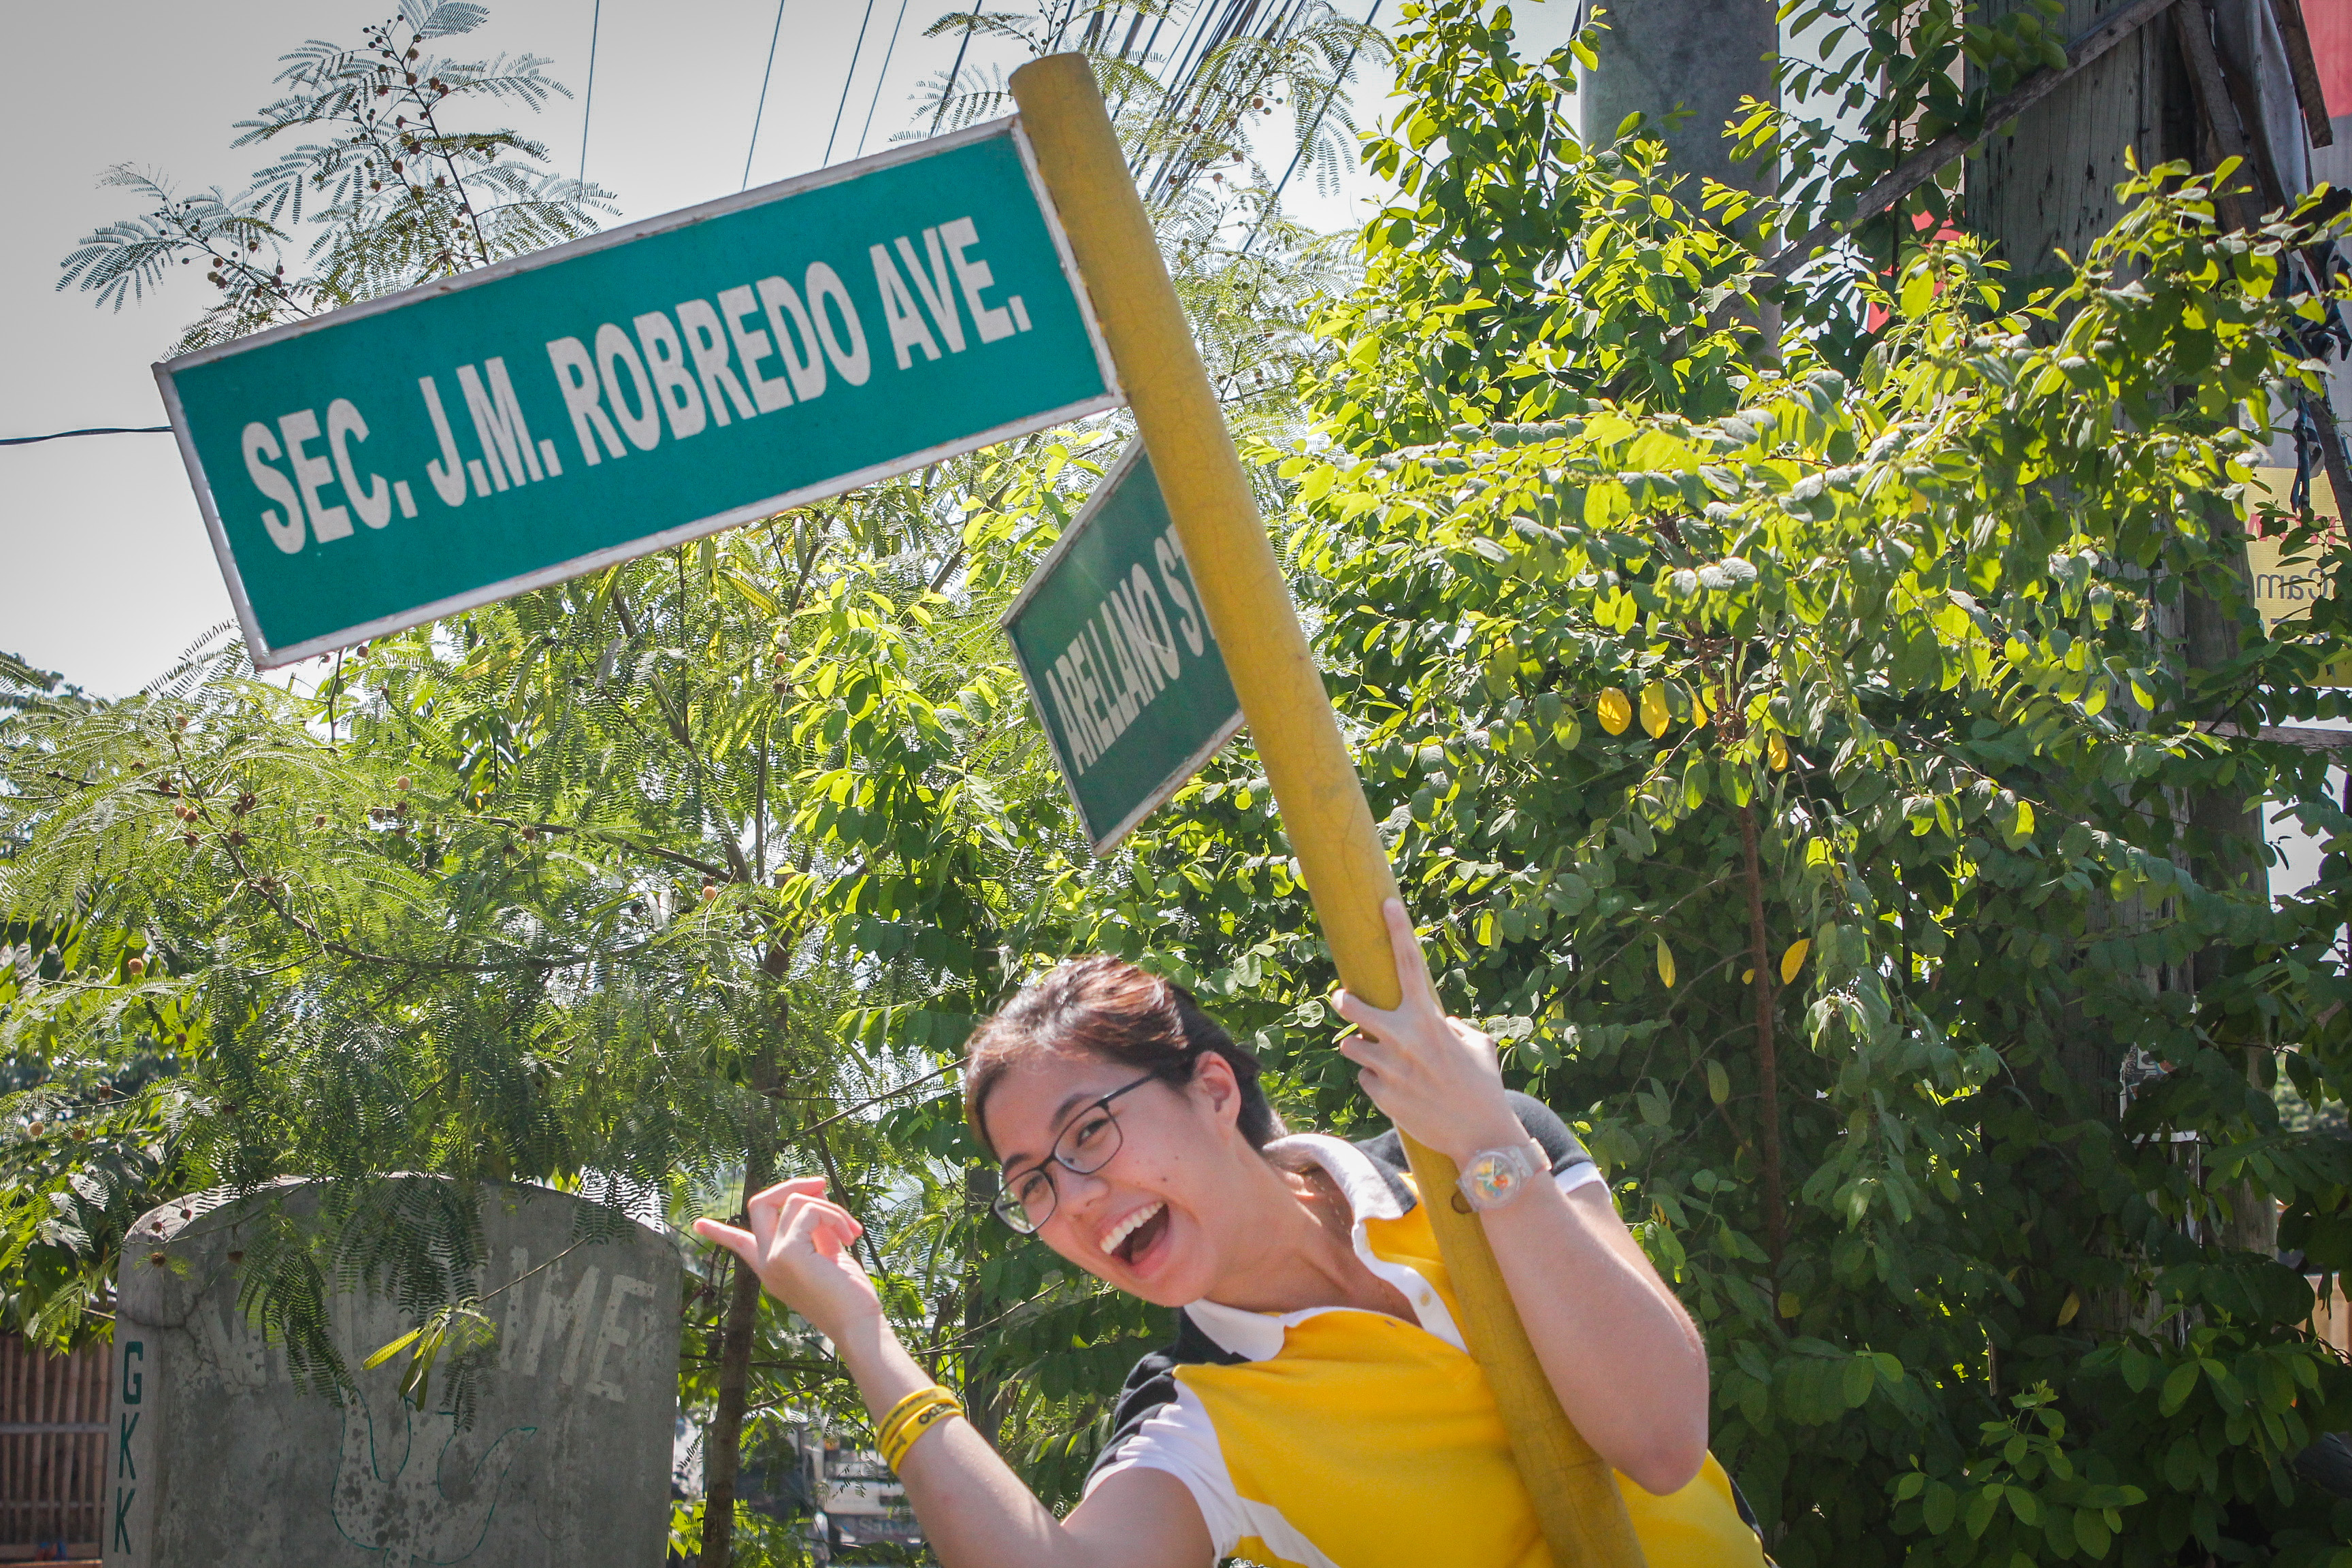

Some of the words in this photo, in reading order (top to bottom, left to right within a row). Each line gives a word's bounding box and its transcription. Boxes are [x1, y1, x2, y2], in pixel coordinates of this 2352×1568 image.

[243, 398, 417, 554] SEC.
[419, 357, 562, 506] J.M.
[546, 261, 870, 466] ROBREDO
[869, 216, 1032, 370] AVE.
[1044, 562, 1181, 777] ARELLANO
